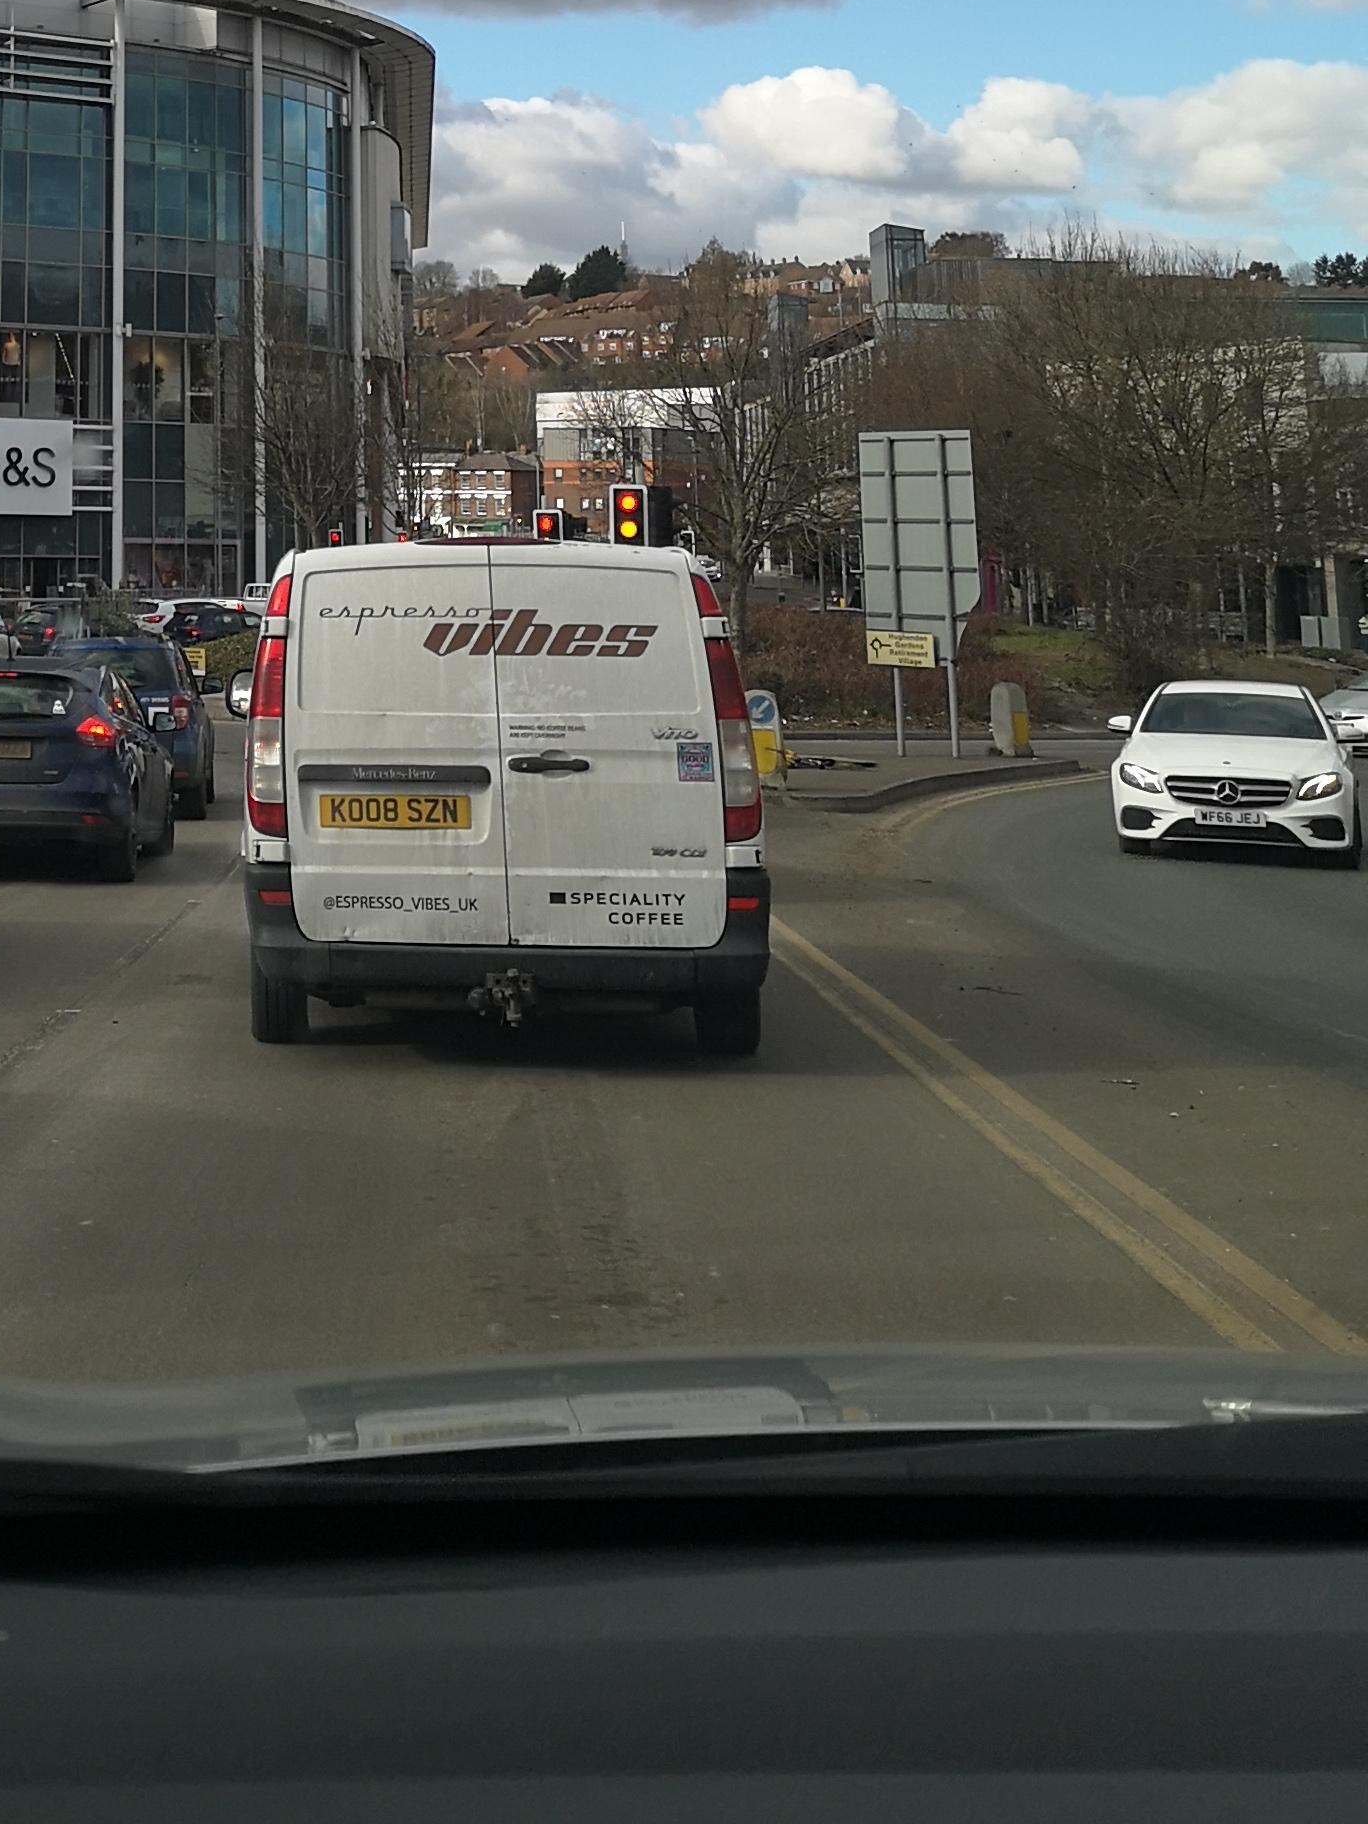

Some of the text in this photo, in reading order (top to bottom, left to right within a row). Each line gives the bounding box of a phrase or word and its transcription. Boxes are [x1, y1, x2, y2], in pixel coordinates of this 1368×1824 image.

[319, 606, 492, 636] espresso
[423, 608, 658, 658] vibes
[888, 633, 928, 642] Hughenden
[895, 641, 924, 650] Gardens
[889, 649, 928, 657] Retirement
[898, 658, 922, 666] Village
[351, 767, 436, 780] Mercedes-Benz
[330, 798, 458, 824] KO08 SZN
[1200, 810, 1261, 825] WF66 JEJ
[323, 895, 478, 913] @ESPRESSO_VIBES_UK
[570, 892, 686, 906] SPECIALITY
[608, 912, 685, 925] COFFEE
